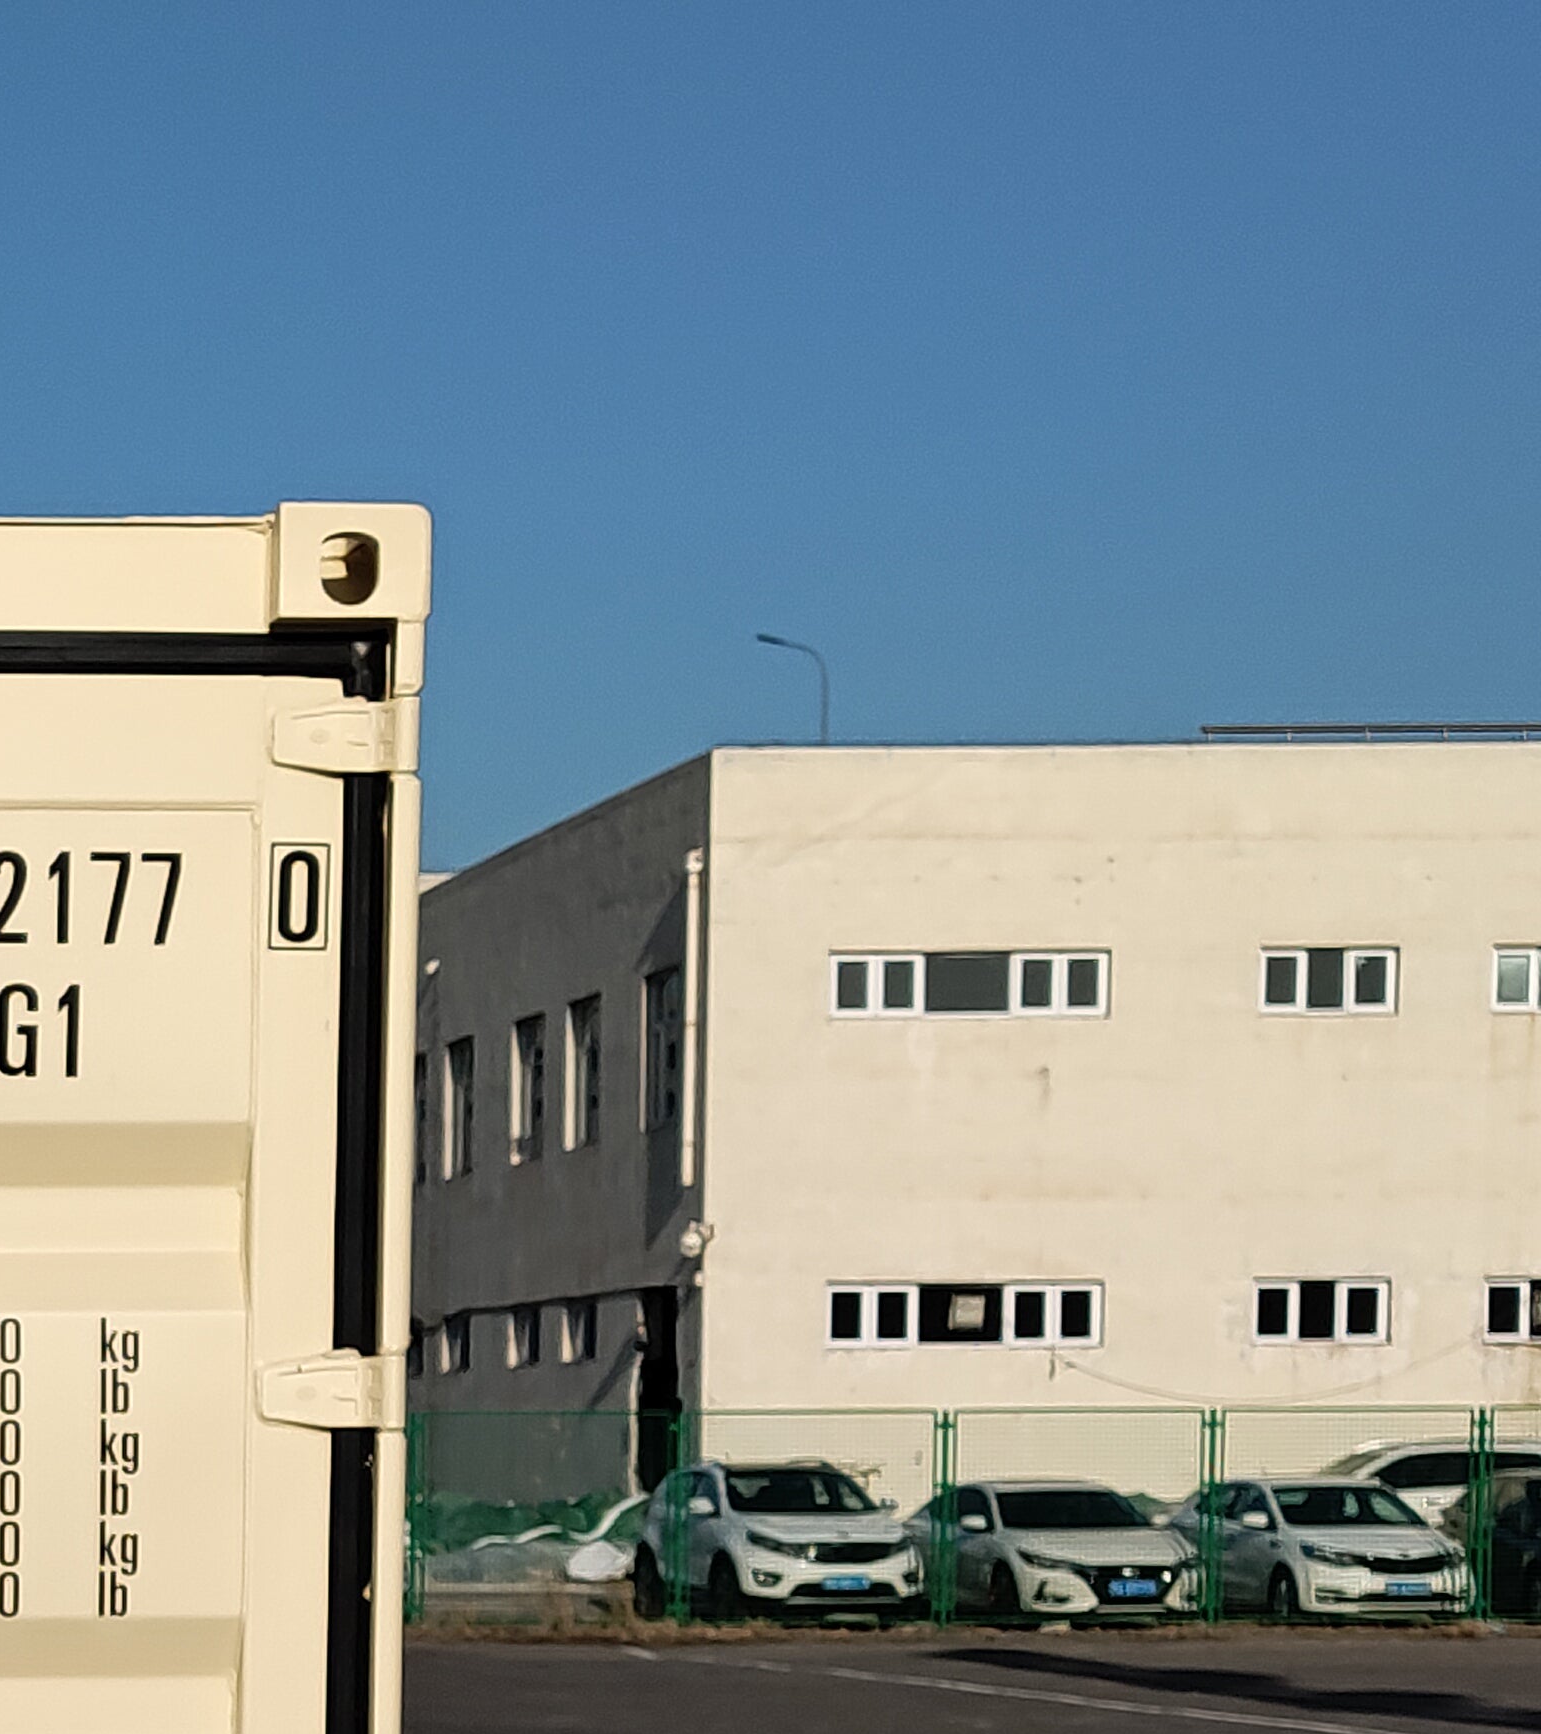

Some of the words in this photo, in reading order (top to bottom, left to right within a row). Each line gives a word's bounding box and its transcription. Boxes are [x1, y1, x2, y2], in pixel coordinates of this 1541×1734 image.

[278, 849, 321, 943] 0
[100, 1317, 140, 1373] kg
[100, 1368, 131, 1415] lb
[99, 1418, 140, 1474] kg
[99, 1470, 130, 1516] lb
[98, 1519, 139, 1577] kg
[98, 1571, 129, 1617] lb
